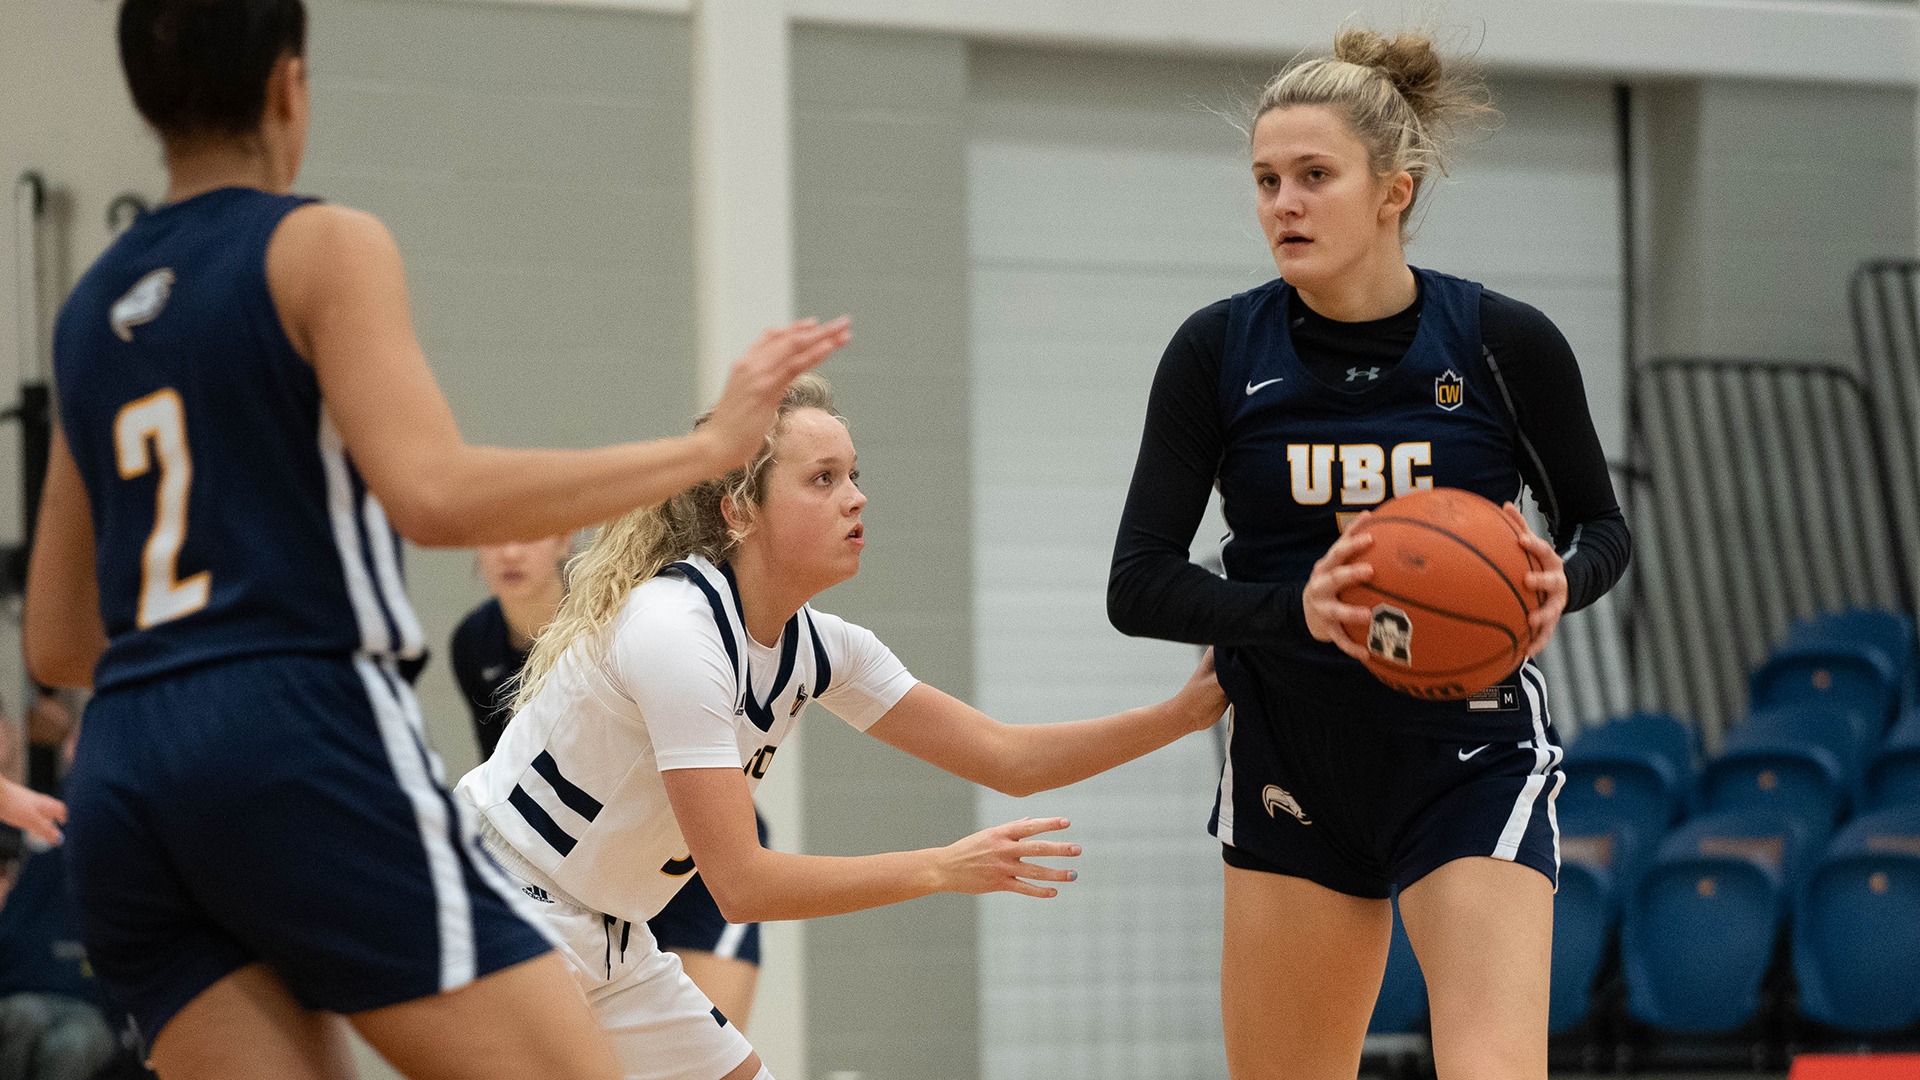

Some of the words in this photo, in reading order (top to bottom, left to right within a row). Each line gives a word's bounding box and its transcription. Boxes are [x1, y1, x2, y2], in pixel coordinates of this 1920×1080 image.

[1439, 384, 1460, 404] CW
[1287, 441, 1434, 506] UBC
[112, 387, 212, 630] 2
[1503, 692, 1513, 705] M
